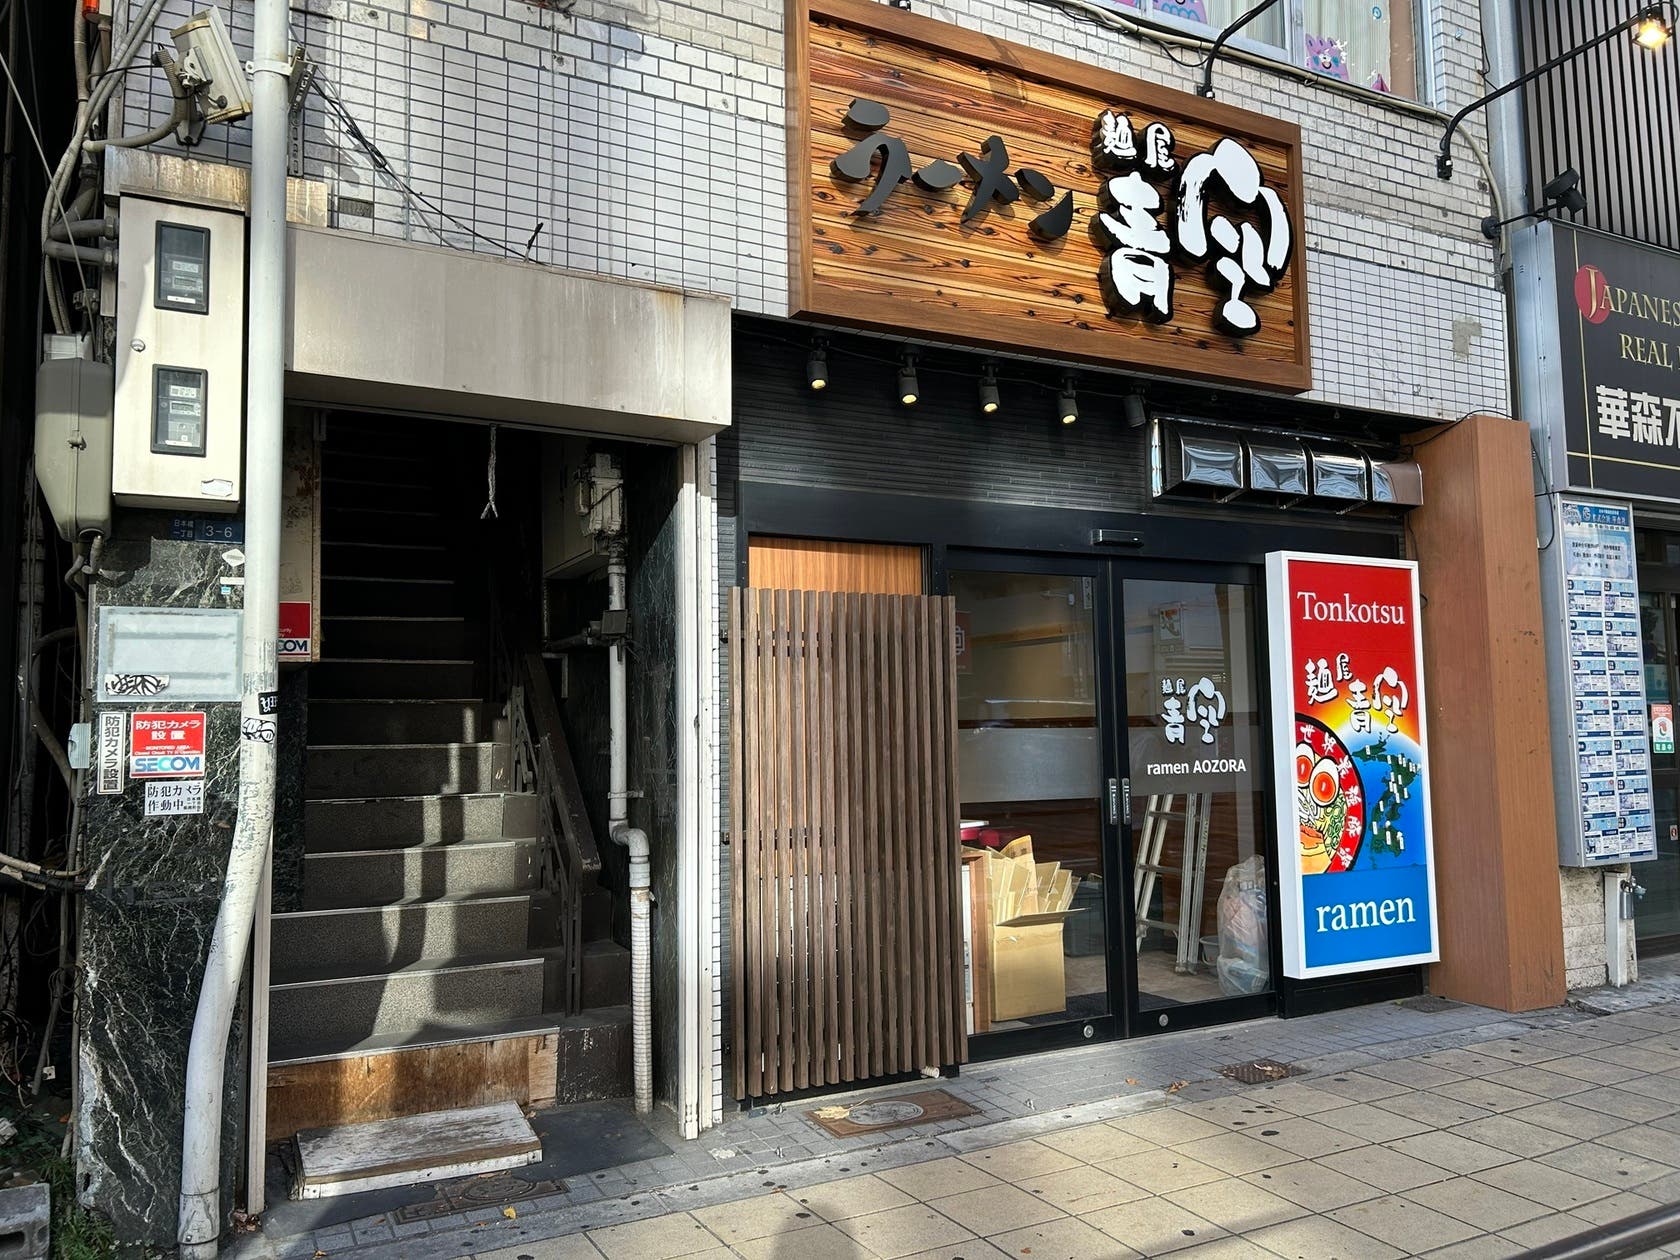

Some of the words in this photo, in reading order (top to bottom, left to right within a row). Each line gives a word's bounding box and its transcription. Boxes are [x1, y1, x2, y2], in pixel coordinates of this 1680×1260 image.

[830, 99, 1073, 243] ラーメン
[1092, 136, 1293, 332] 青空
[1619, 333, 1673, 371] REAL
[205, 525, 233, 538] 3-6
[1297, 591, 1406, 625] Tonkotsu
[1160, 676, 1227, 744] 青空
[1345, 666, 1409, 733] 青空
[135, 719, 202, 730] 防犯カメラ
[151, 730, 186, 740] 設置
[104, 716, 121, 790] 防犯カメラ設置
[135, 756, 200, 772] SECOM
[1147, 762, 1189, 775] ramen
[1193, 759, 1247, 773] AOZORA
[147, 784, 202, 798] 防犯カメラ
[148, 799, 184, 812] 作動中
[1316, 897, 1416, 932] ramen
